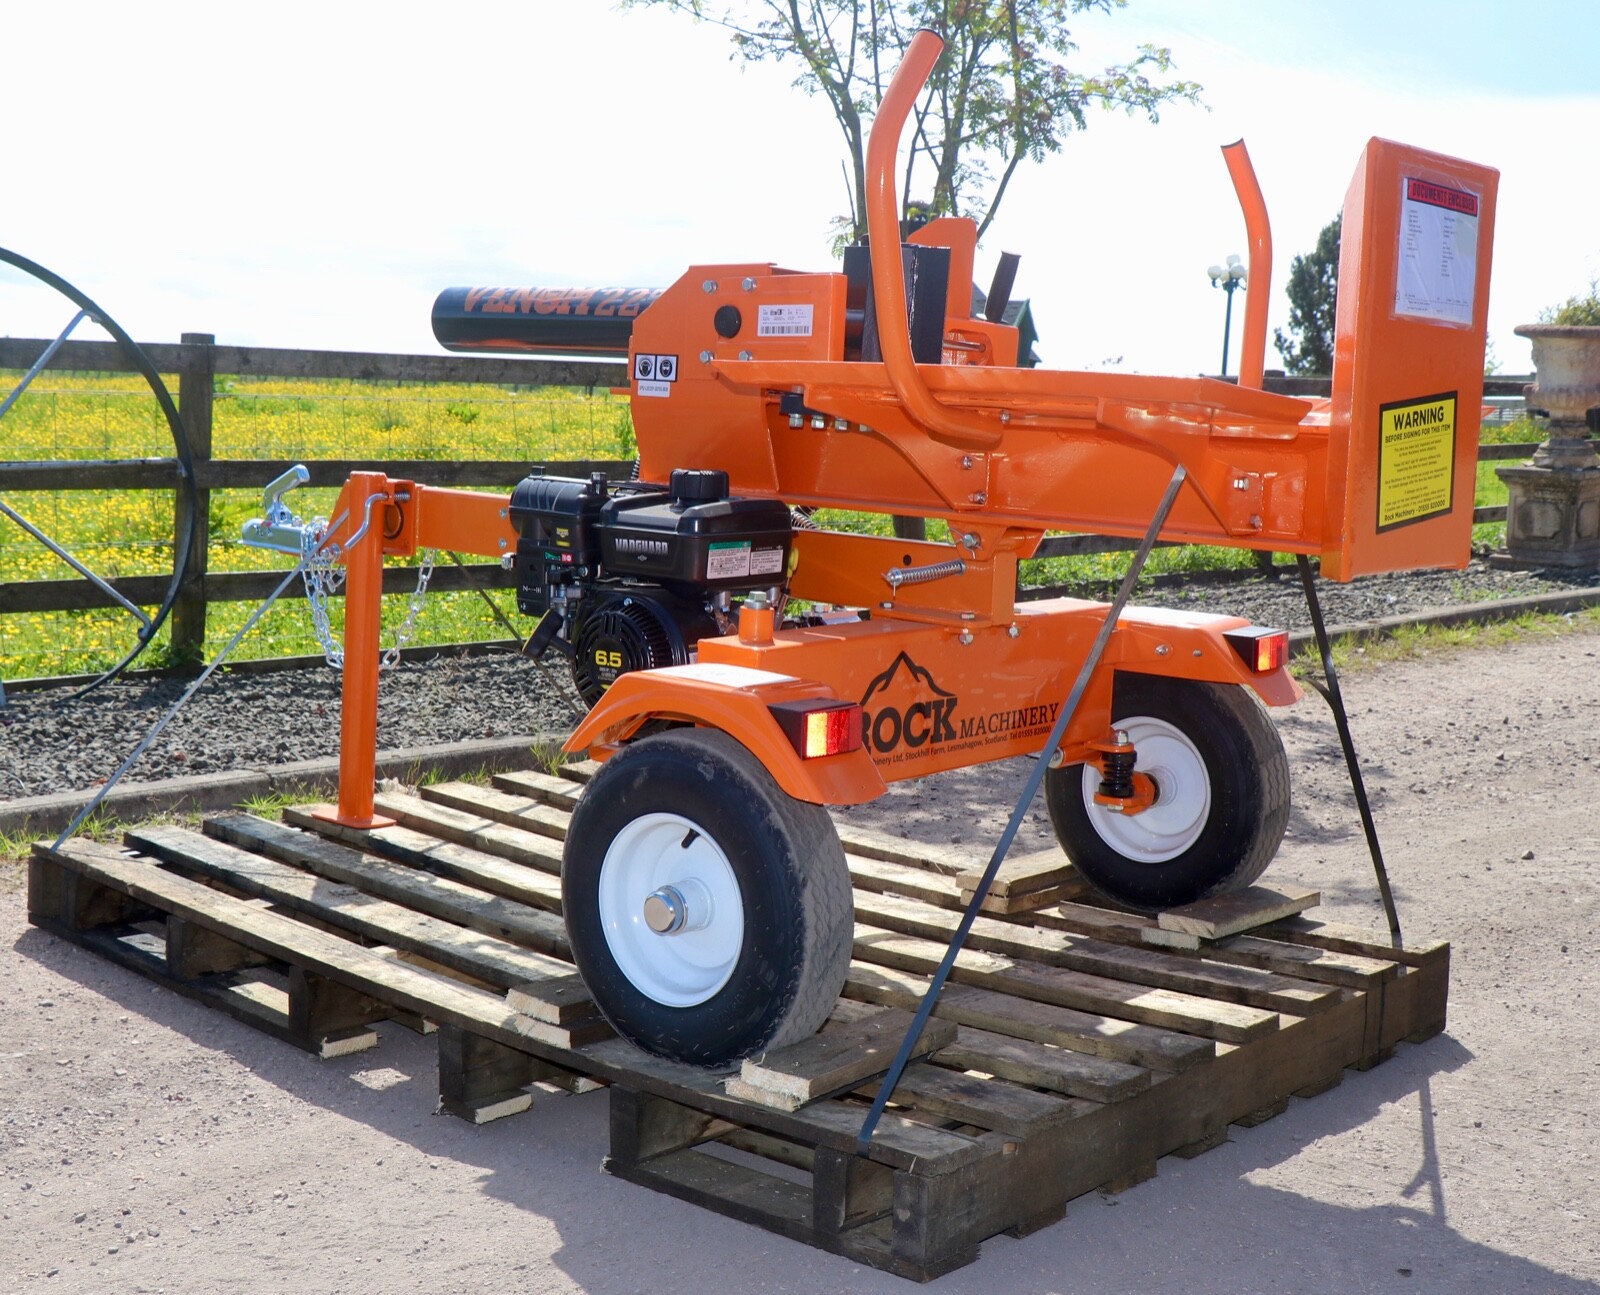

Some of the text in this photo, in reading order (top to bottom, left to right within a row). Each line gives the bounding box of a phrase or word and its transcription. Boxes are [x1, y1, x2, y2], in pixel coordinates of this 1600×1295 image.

[1412, 182, 1475, 212] DOCUMENTS ENCLOSED
[464, 286, 596, 314] VENOM
[1394, 406, 1444, 430] WARNING
[1385, 432, 1403, 444] BEFORE
[1403, 429, 1421, 439] SIGNING
[1421, 427, 1431, 436] FOR
[1440, 423, 1451, 432] ITEM
[1384, 512, 1395, 521] Rock
[1394, 508, 1416, 520] Machinery
[614, 538, 669, 555] VANGUARD
[595, 649, 622, 668] 6.5
[960, 703, 1059, 739] MACHINERY
[904, 747, 930, 761] Stockhill
[930, 745, 946, 756] Farm,
[947, 738, 984, 753] Lesmahagow,
[1009, 731, 1018, 740] Tel
[1017, 728, 1033, 739] 01555
